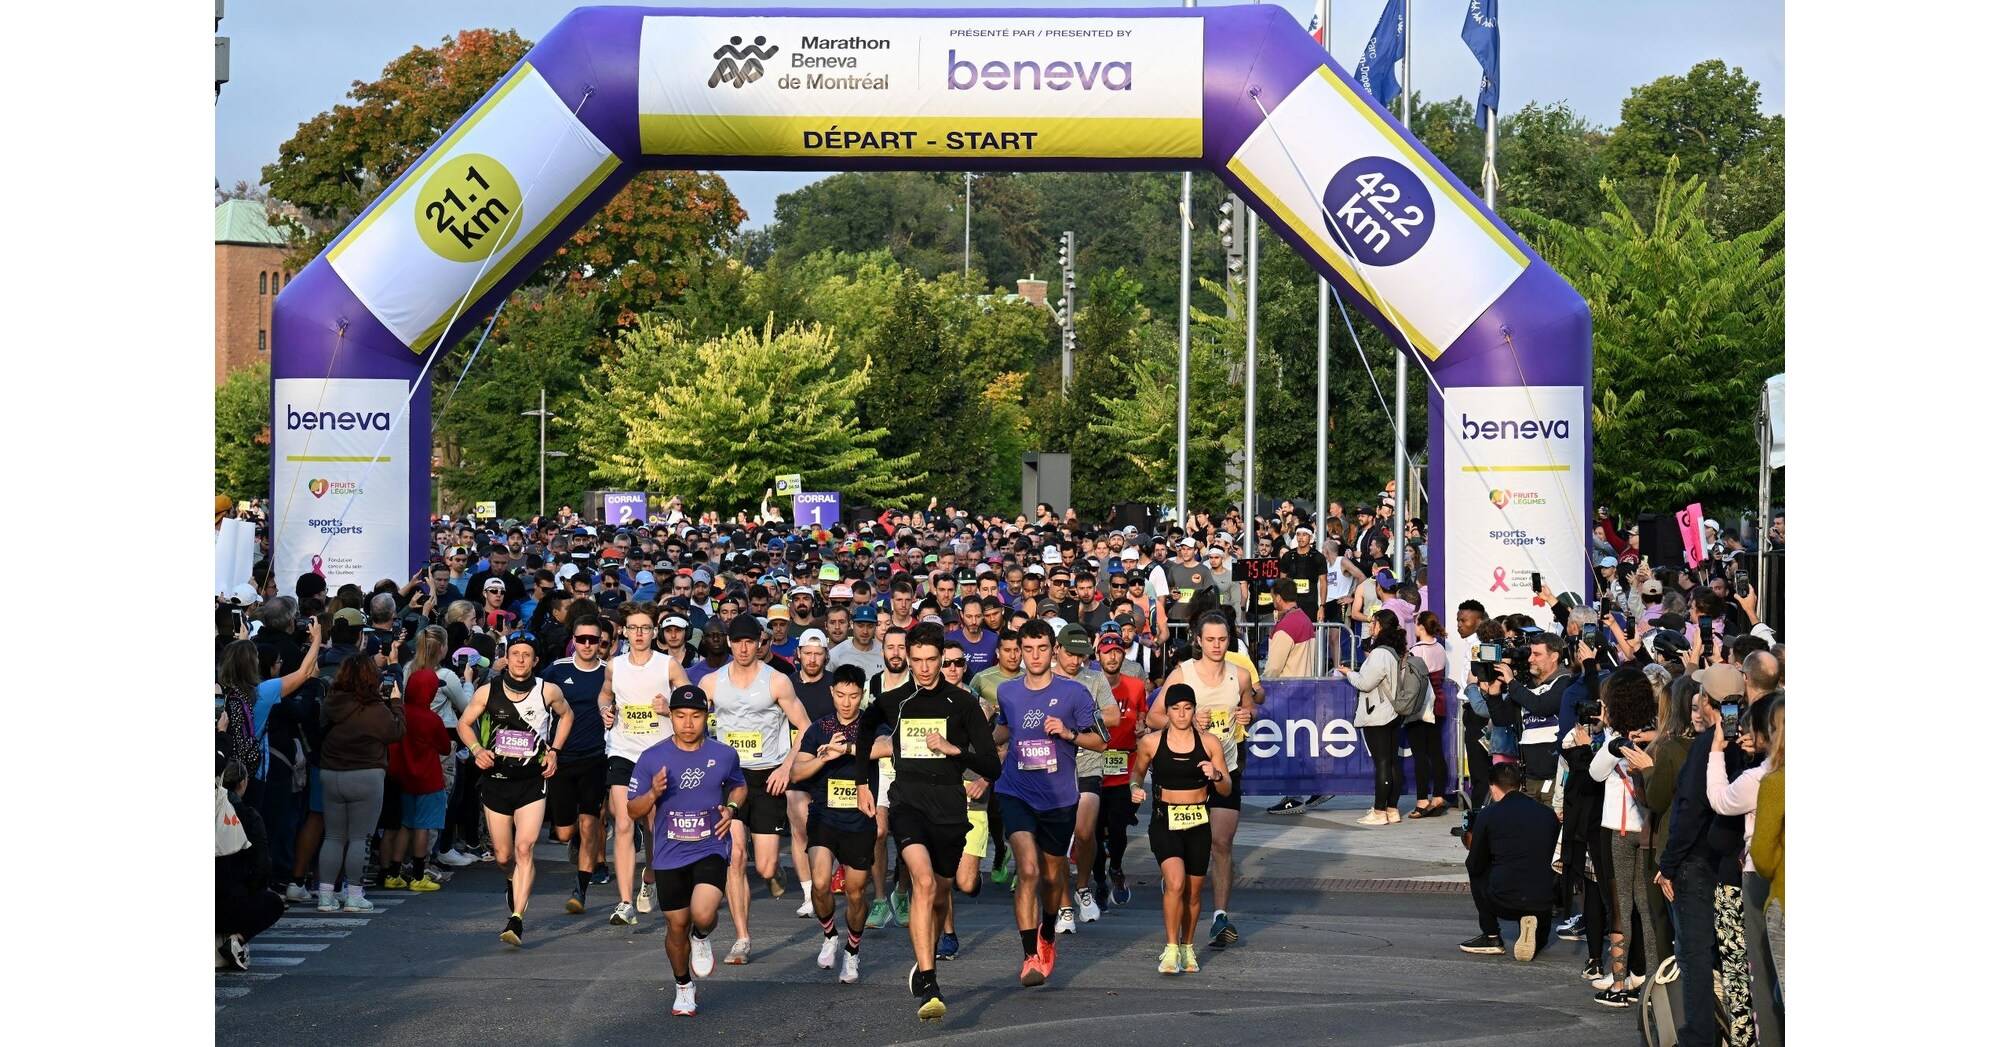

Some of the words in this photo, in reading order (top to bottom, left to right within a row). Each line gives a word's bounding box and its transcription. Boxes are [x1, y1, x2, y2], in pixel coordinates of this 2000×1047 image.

[950, 28, 1009, 37] PRÉSENTÉ
[1012, 29, 1035, 37] PAR
[1037, 29, 1043, 37] /
[1045, 29, 1114, 37] PRESENTED
[1116, 29, 1132, 37] BY
[801, 36, 890, 50] Marathon
[791, 53, 857, 68] Beneva
[947, 49, 1132, 91] beneva
[777, 73, 801, 90] de
[806, 72, 889, 90] Montréal
[803, 125, 918, 149] DÉPART
[946, 131, 1038, 150] START
[425, 165, 490, 234] 21.1
[1355, 172, 1424, 238] 42.2
[448, 198, 510, 250] km
[1336, 192, 1391, 254] km
[287, 404, 390, 431] beneva
[1462, 413, 1569, 440] beneva
[608, 494, 643, 504] CORRAL
[797, 494, 837, 503] CORRAL
[619, 505, 633, 524] 2
[810, 506, 821, 524] 1
[308, 518, 343, 528] sports
[320, 525, 363, 536] experts
[1489, 529, 1527, 540] sports
[626, 711, 652, 720] 24284
[500, 736, 529, 747] 12586
[729, 739, 757, 749] 25108
[1246, 718, 1372, 758] ene
[1020, 746, 1051, 757] 13068
[672, 817, 705, 828] 10574
[1174, 812, 1202, 821] 23619
